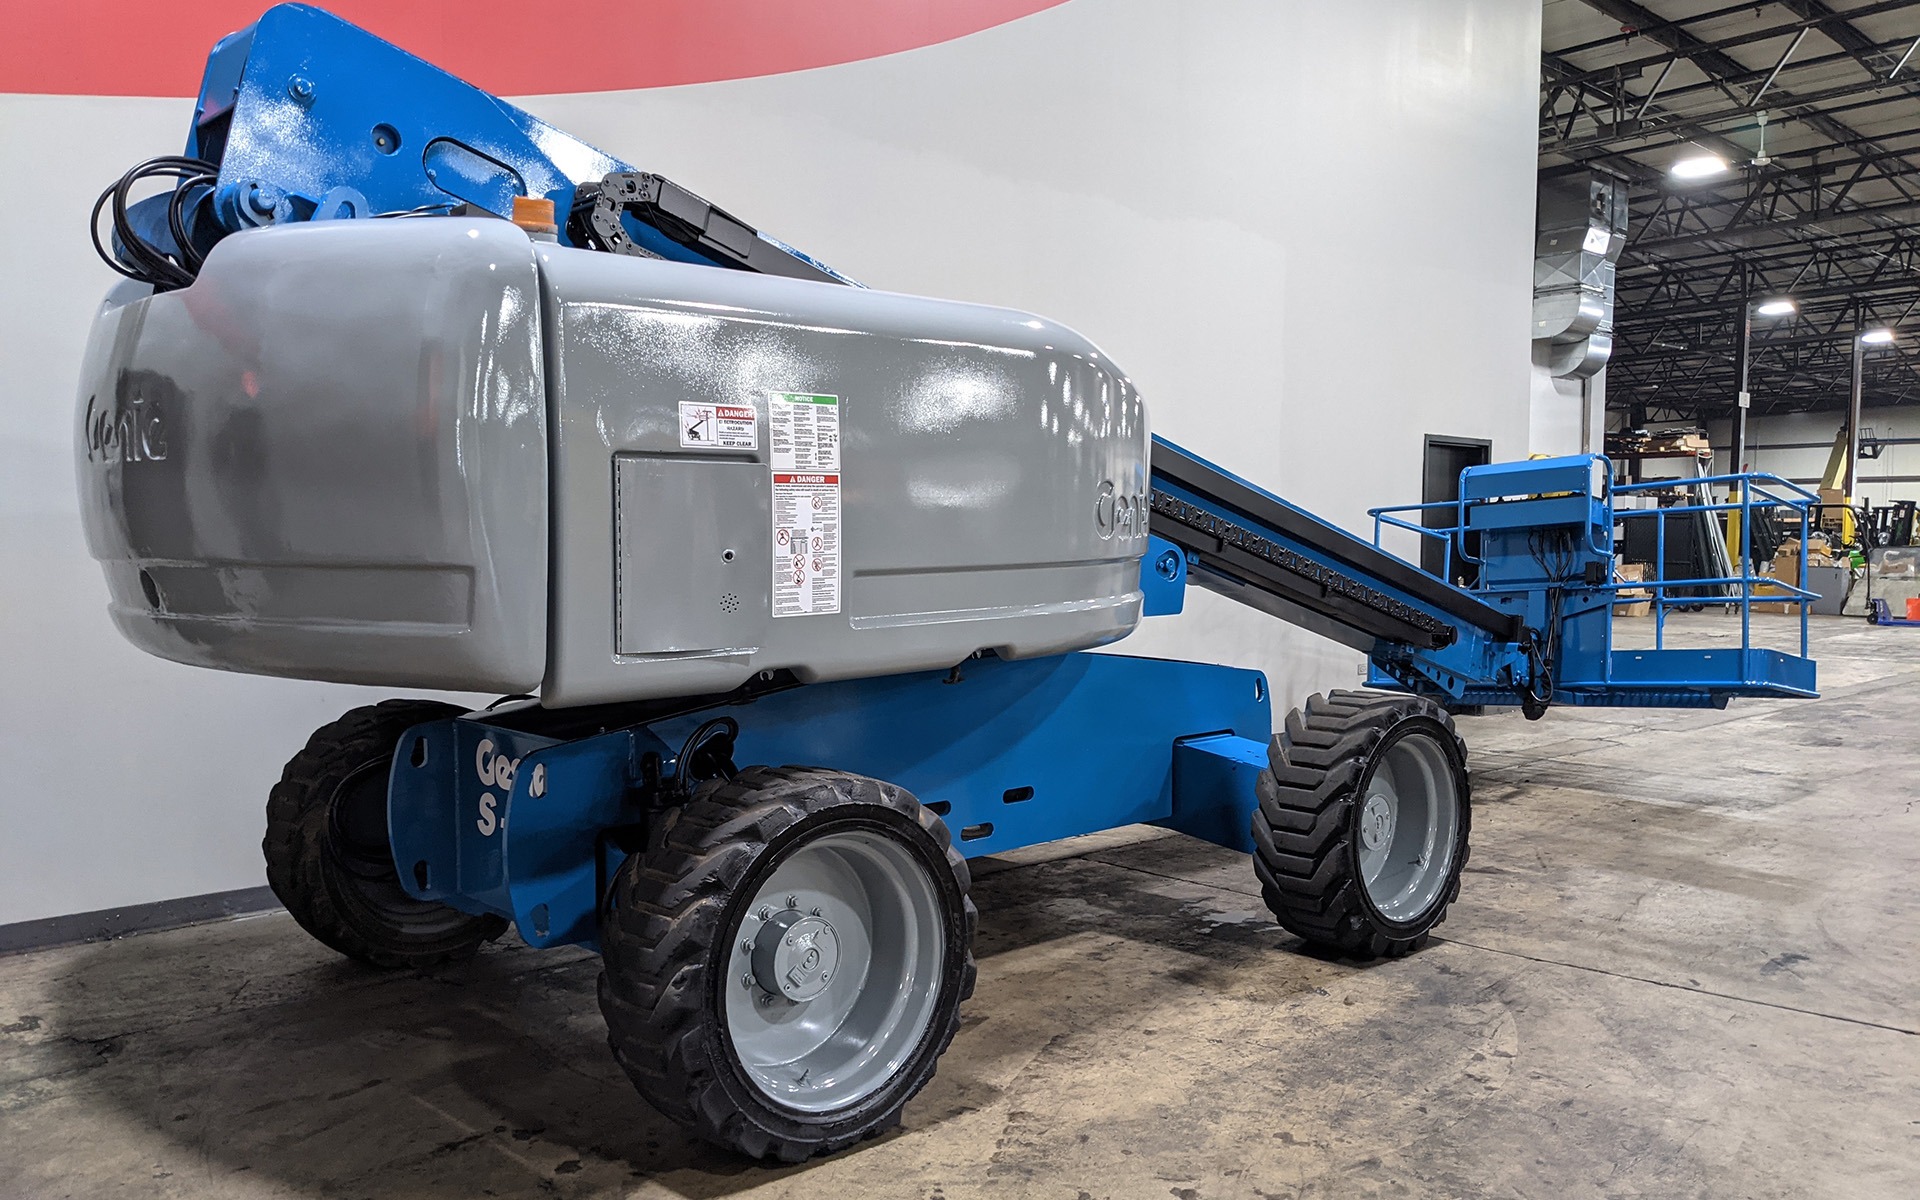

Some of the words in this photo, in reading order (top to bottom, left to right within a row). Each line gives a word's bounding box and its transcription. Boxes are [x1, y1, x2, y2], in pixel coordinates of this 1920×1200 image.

[794, 395, 814, 403] NOTICE
[724, 408, 755, 418] DANGER
[796, 475, 825, 483] DANGER
